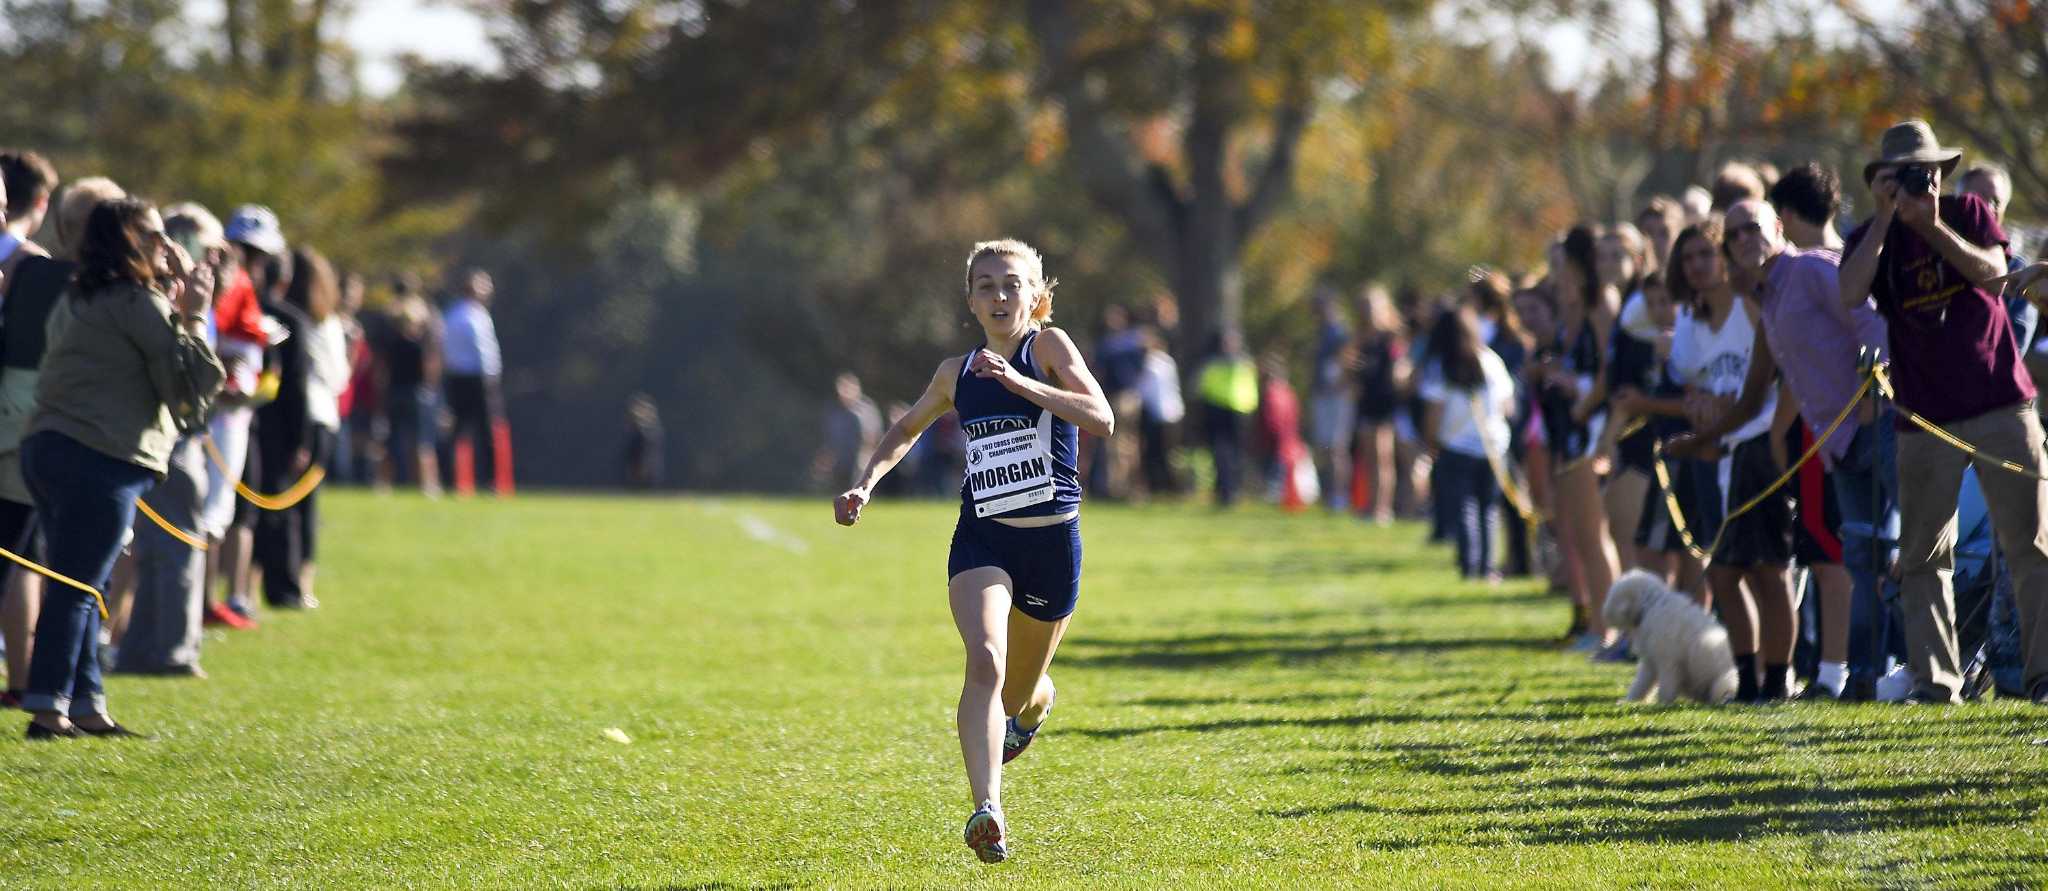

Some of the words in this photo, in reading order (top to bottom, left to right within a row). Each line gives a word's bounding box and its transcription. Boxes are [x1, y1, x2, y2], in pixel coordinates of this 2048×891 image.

[982, 443, 994, 451] 2017
[993, 439, 1011, 449] CROSS
[1011, 433, 1037, 444] COUNTRY
[988, 443, 1033, 458] CHAMPIONSHIPS
[971, 457, 1046, 492] MORGAN
